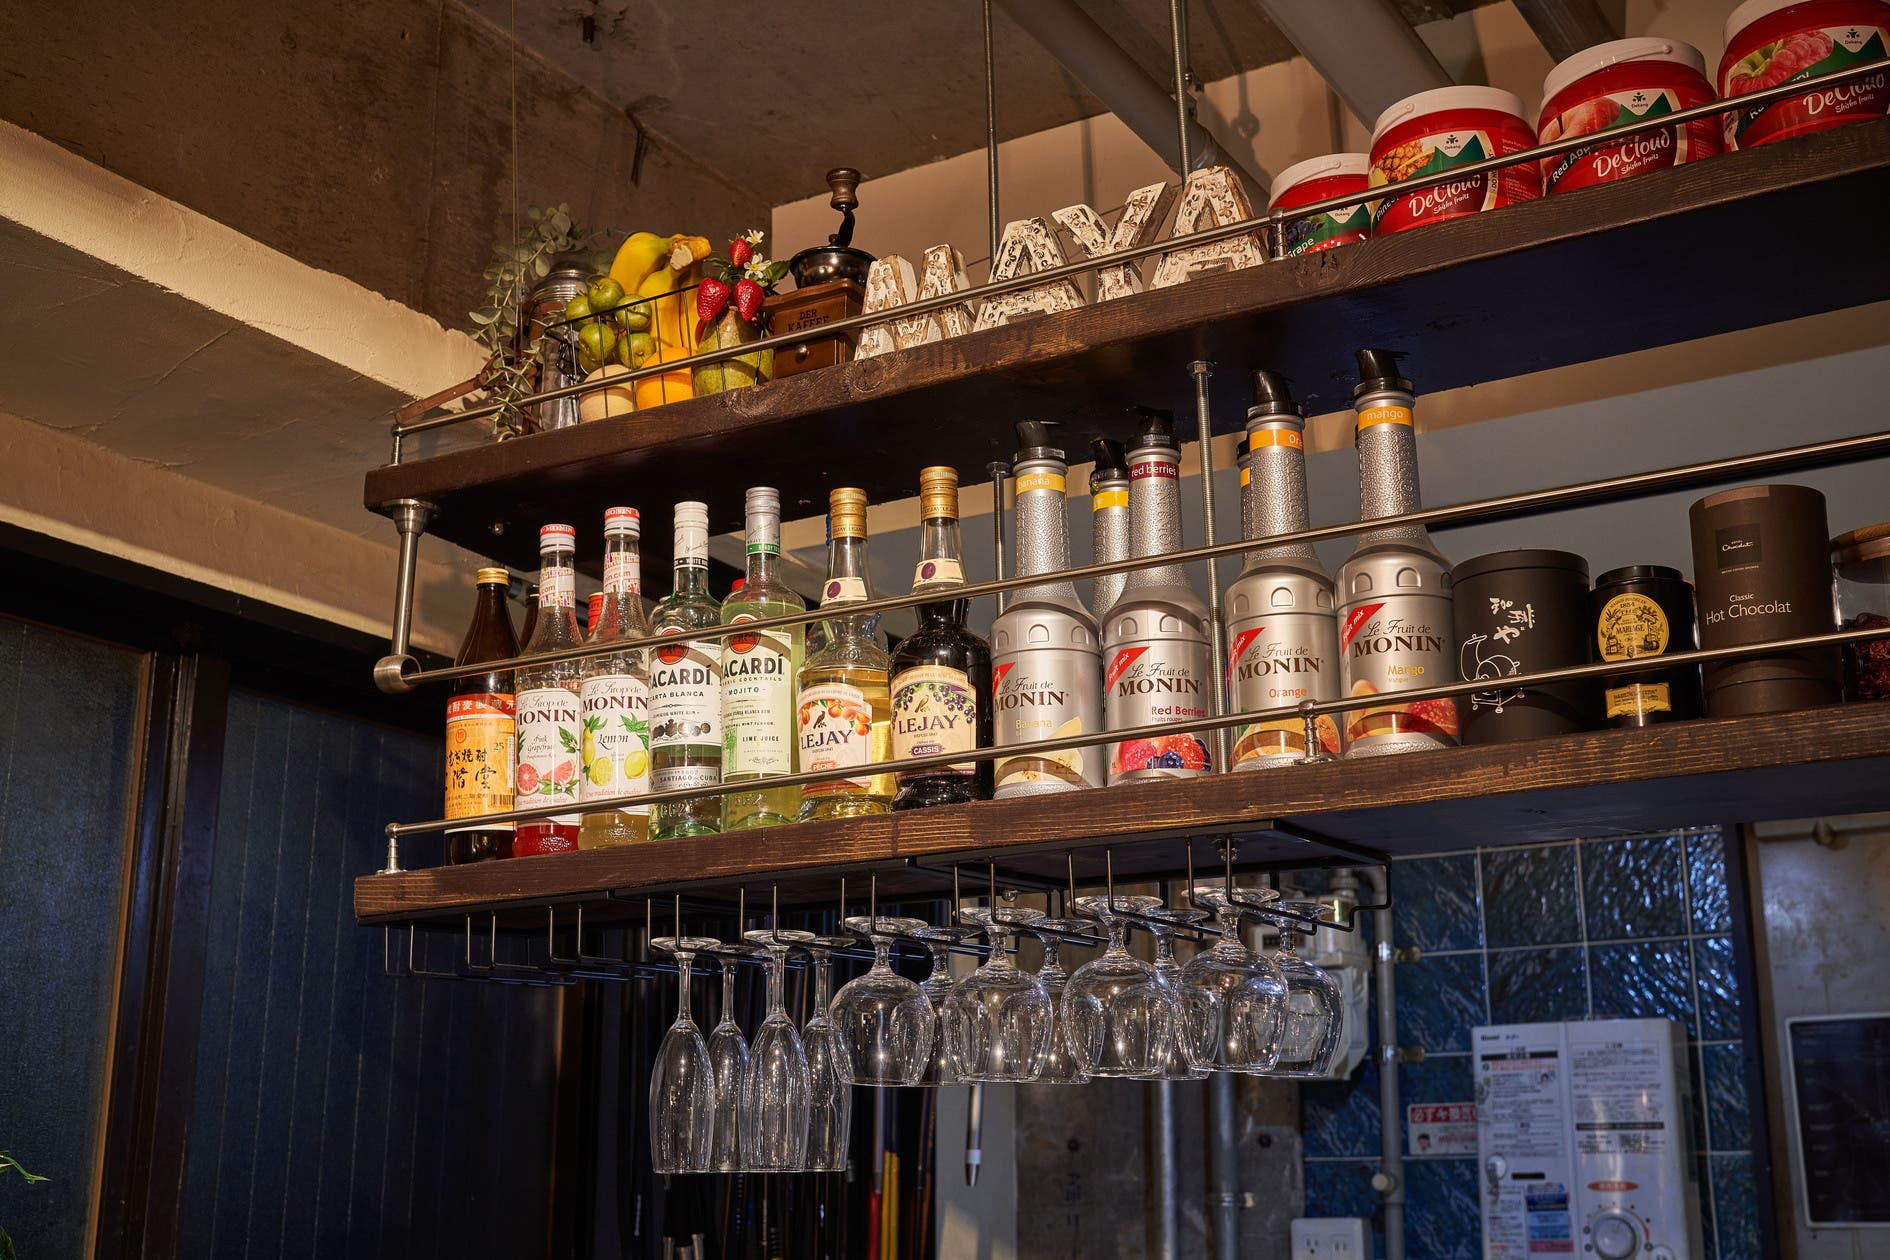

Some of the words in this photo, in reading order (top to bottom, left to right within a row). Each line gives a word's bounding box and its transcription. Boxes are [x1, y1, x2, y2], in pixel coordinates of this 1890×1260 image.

[1592, 128, 1670, 177] DeCloud
[1552, 162, 1569, 182] Red
[800, 308, 817, 320] DER
[1366, 409, 1404, 421] mango
[1131, 467, 1145, 478] red
[1146, 465, 1177, 476] berries
[1018, 478, 1050, 488] banana
[1729, 593, 1755, 602] Classic
[1353, 609, 1365, 625] mix
[1705, 610, 1726, 625] Hot
[1728, 600, 1792, 618] Chocolat
[1363, 621, 1381, 638] Le
[1383, 618, 1415, 635] Fruit
[1417, 624, 1432, 634] de
[1244, 645, 1261, 662] Le
[1262, 642, 1292, 658] Fruit
[1295, 646, 1308, 656] de
[1354, 635, 1442, 658] MONIN
[721, 653, 783, 679] ACARDÍ
[1118, 651, 1130, 667] mix
[650, 663, 712, 690] ACARDÍ
[1127, 663, 1145, 679] Le
[1146, 662, 1175, 677] Fruit
[1177, 667, 1190, 677] de
[1238, 657, 1320, 682] MONIN
[1388, 665, 1425, 677] Mango
[669, 690, 704, 698] BLANCA
[728, 686, 760, 696] MOJITO
[999, 679, 1011, 695] Le
[1040, 680, 1054, 690] de
[1118, 678, 1201, 698] MONIN
[1268, 687, 1307, 699] Orange
[582, 695, 648, 714] MONIN
[994, 690, 1065, 713] MONIN
[1151, 705, 1172, 716] Red
[1175, 705, 1206, 718] Berries
[898, 714, 958, 735] LEJAY
[494, 742, 505, 751] 25
[598, 732, 629, 751] Lemon
[801, 729, 853, 750] LEJAY
[913, 745, 939, 755] CASSIS
[659, 775, 693, 783] SANTIAGO
